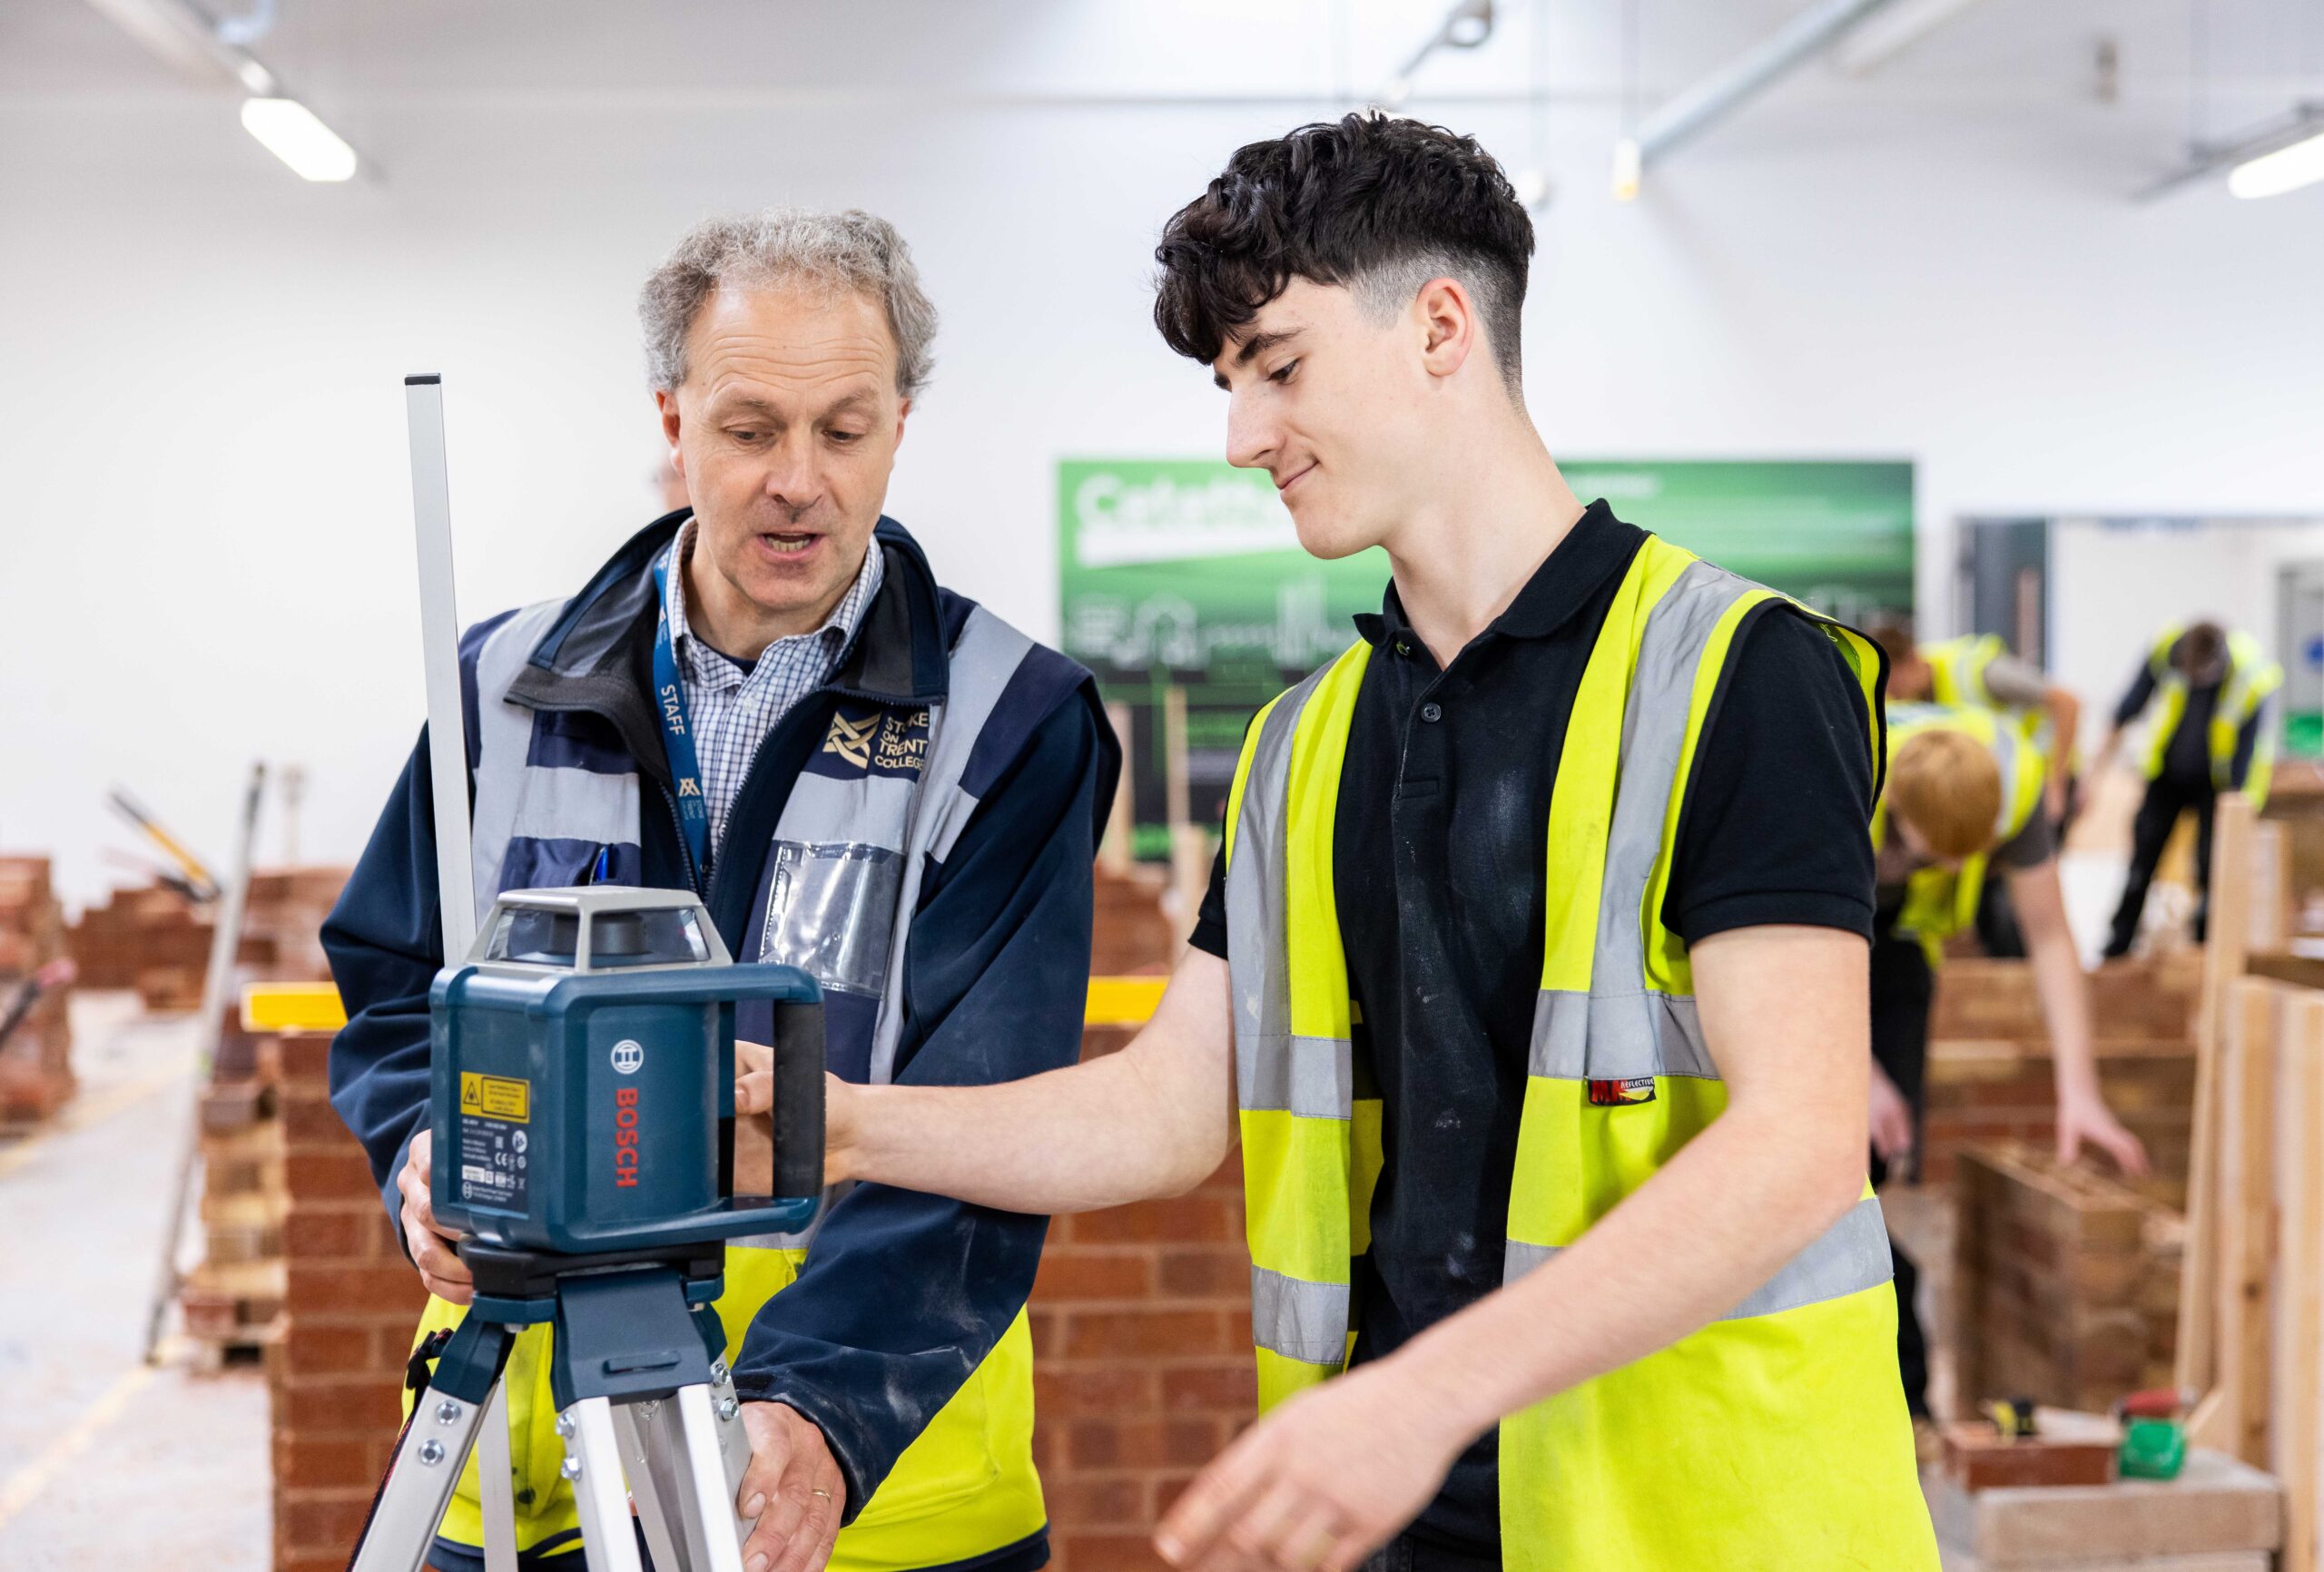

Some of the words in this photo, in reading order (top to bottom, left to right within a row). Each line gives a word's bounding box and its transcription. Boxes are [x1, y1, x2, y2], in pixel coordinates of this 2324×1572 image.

[661, 684, 685, 736] STAFF
[880, 739, 928, 756] TRENT
[882, 730, 900, 743] ON
[615, 1088, 638, 1187] BOSCH
